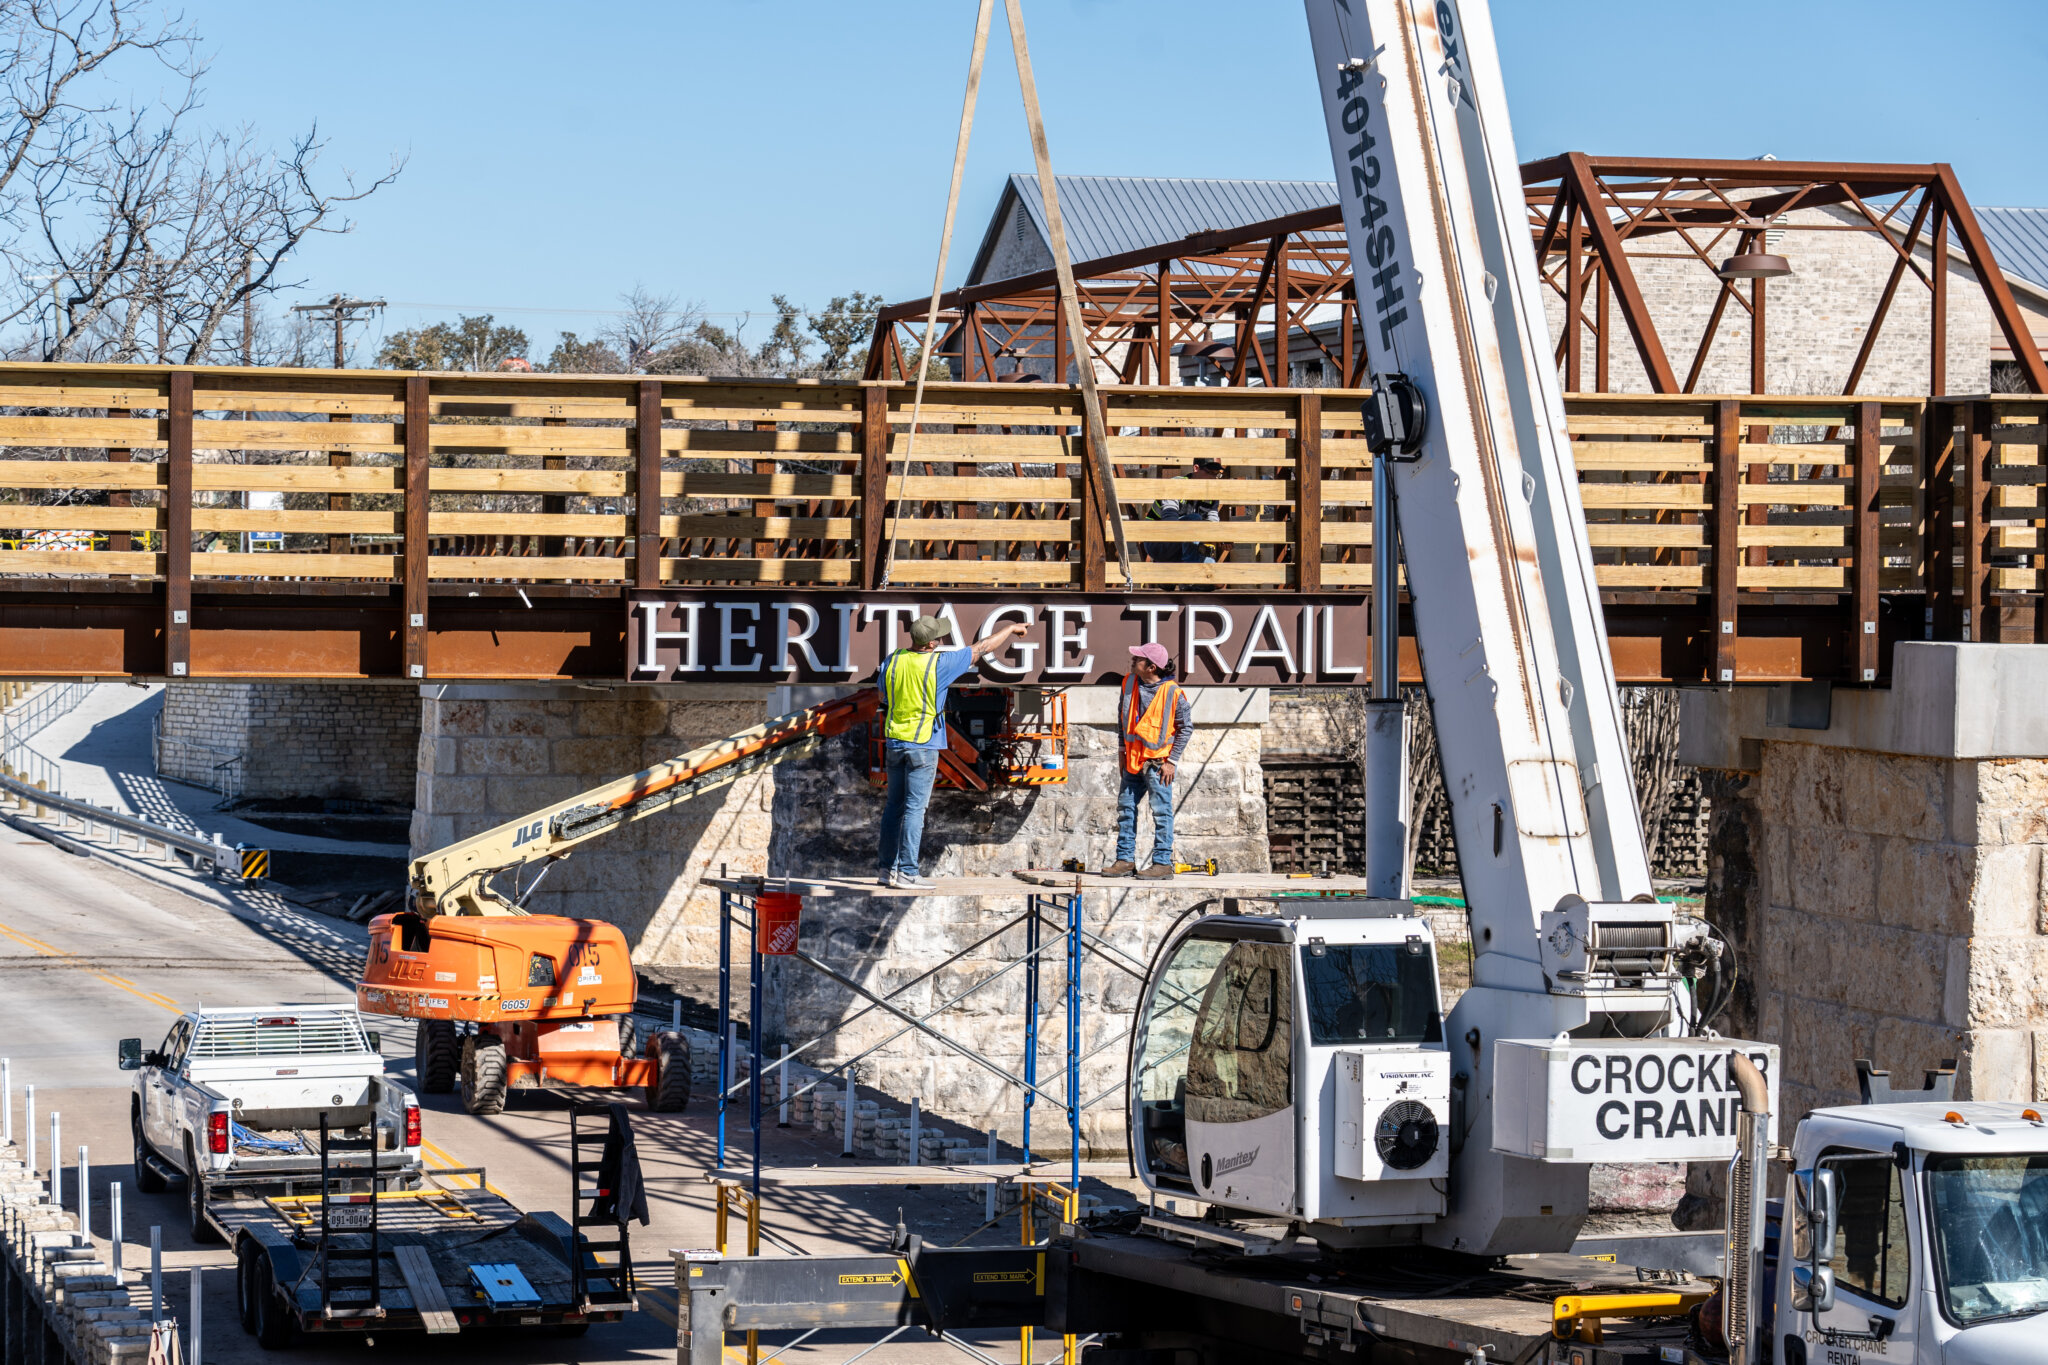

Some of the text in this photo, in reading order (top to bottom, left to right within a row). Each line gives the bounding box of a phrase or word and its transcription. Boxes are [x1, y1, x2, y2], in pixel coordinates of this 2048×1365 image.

[1337, 68, 1408, 352] 40124SHL
[638, 602, 1363, 674] HERITAGE TRAIL
[512, 820, 543, 848] JLG
[568, 943, 600, 966] 015
[388, 960, 427, 980] JLG
[501, 999, 530, 1009] 660SJ
[1216, 1150, 1255, 1172] Manitex
[1805, 1330, 1887, 1355] CROKER CRANE
